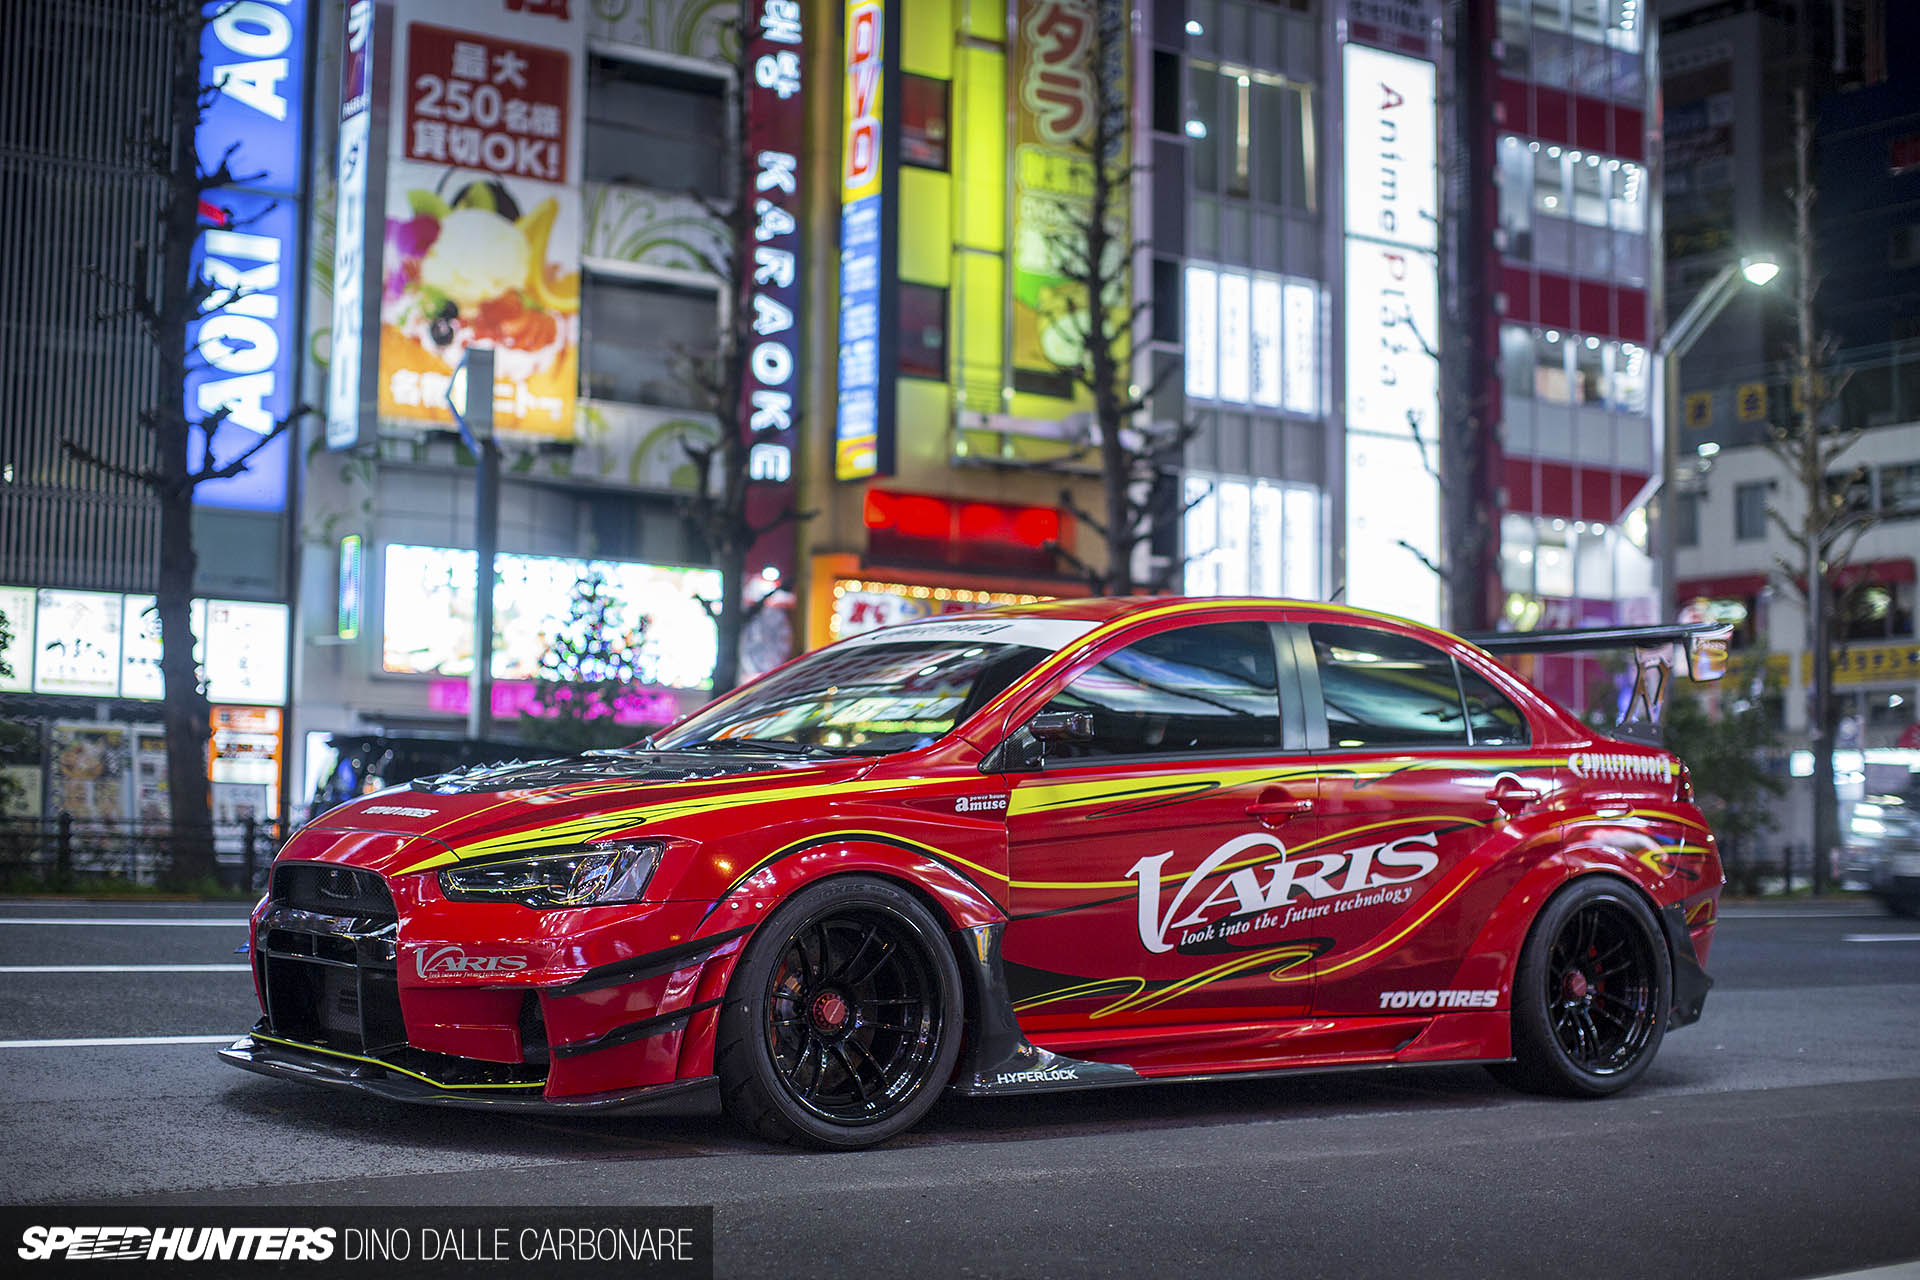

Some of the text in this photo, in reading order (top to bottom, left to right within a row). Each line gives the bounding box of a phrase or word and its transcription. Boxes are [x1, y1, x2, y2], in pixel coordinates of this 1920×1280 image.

[213, 0, 293, 121] AO
[453, 41, 529, 89] 最大
[198, 229, 281, 435] AOKI
[750, 151, 798, 482] KARAOKE
[955, 797, 1006, 812] amuse
[1180, 886, 1412, 946] look into the future technology
[997, 1069, 1079, 1084] HYPERLOCK
